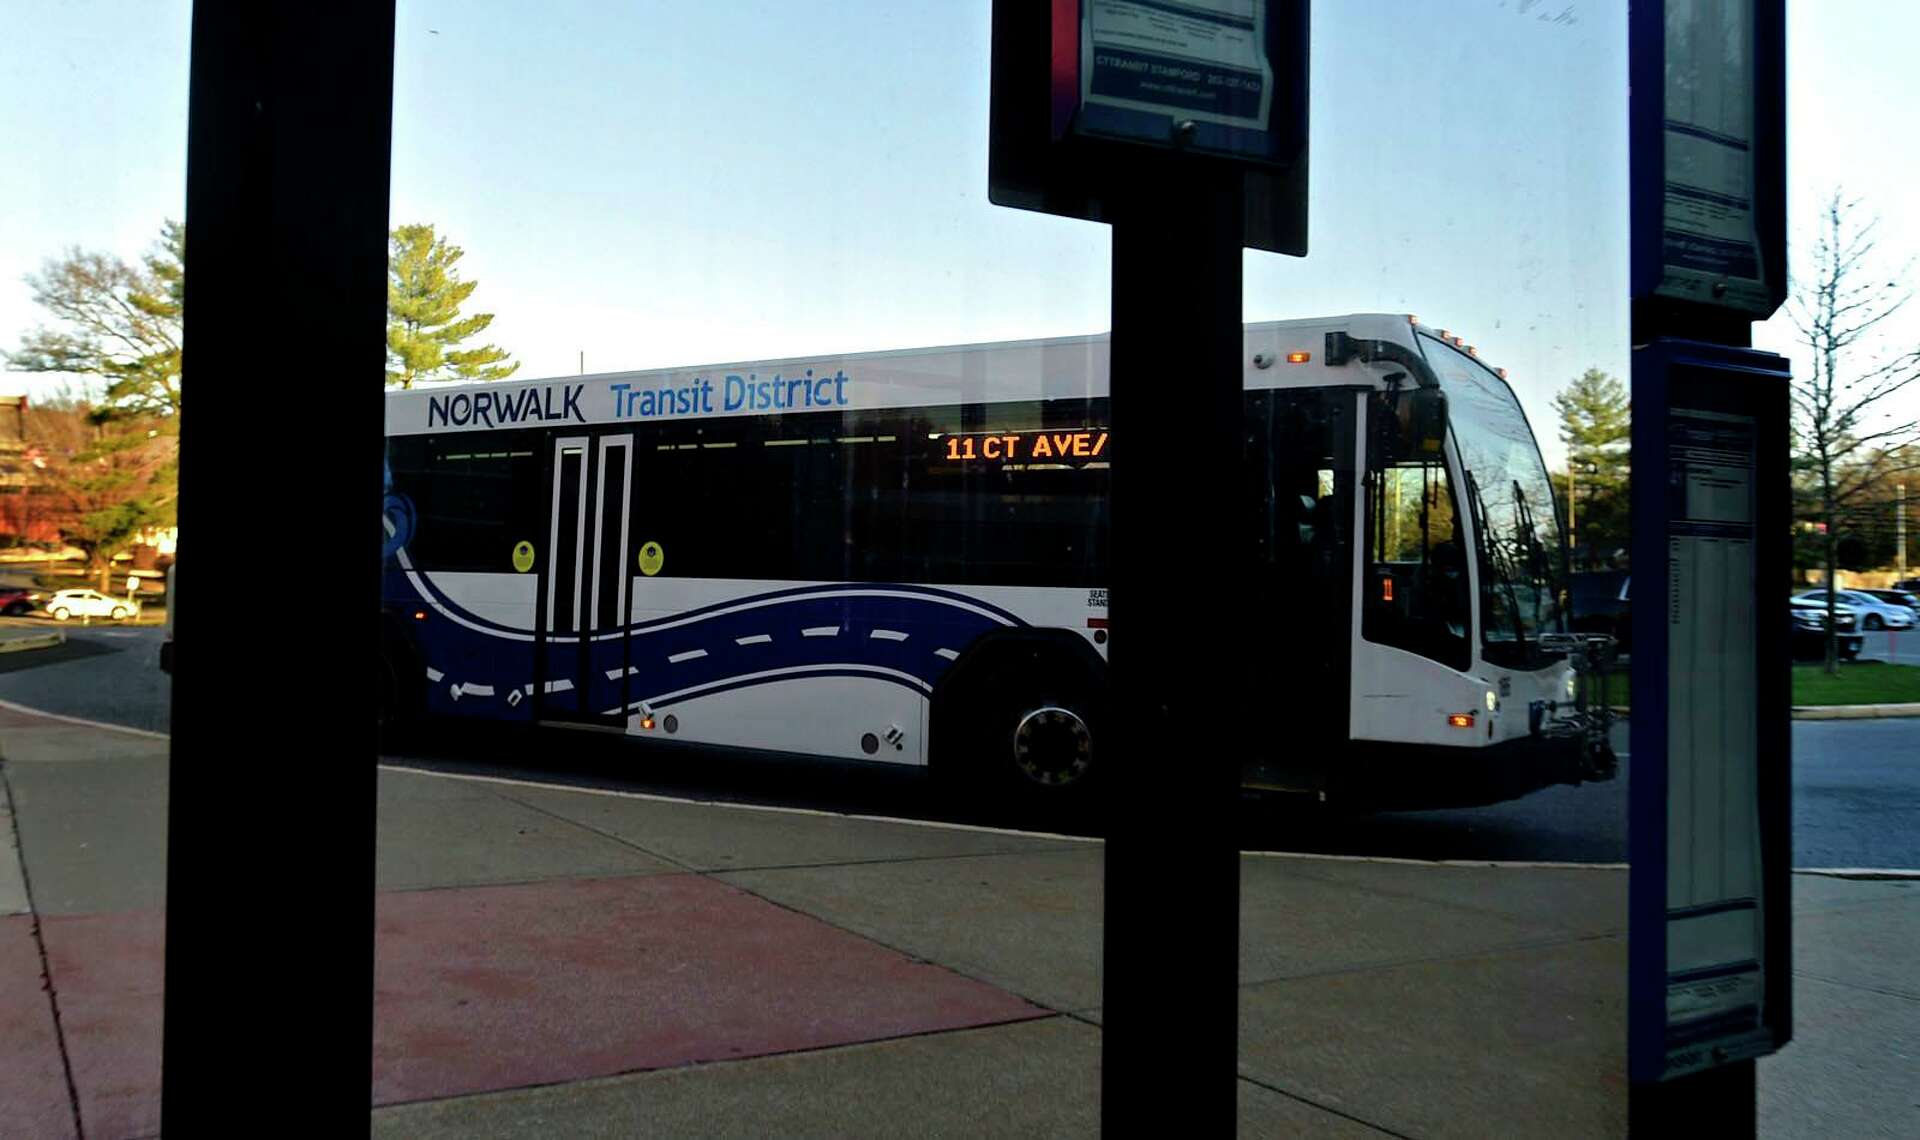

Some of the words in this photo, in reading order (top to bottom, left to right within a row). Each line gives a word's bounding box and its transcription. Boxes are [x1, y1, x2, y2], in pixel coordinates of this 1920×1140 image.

[428, 384, 586, 427] NORWALK
[610, 378, 713, 418] Transit
[724, 370, 849, 411] District
[947, 438, 977, 459] 11
[983, 436, 1020, 458] CT
[1032, 433, 1108, 456] AVE/
